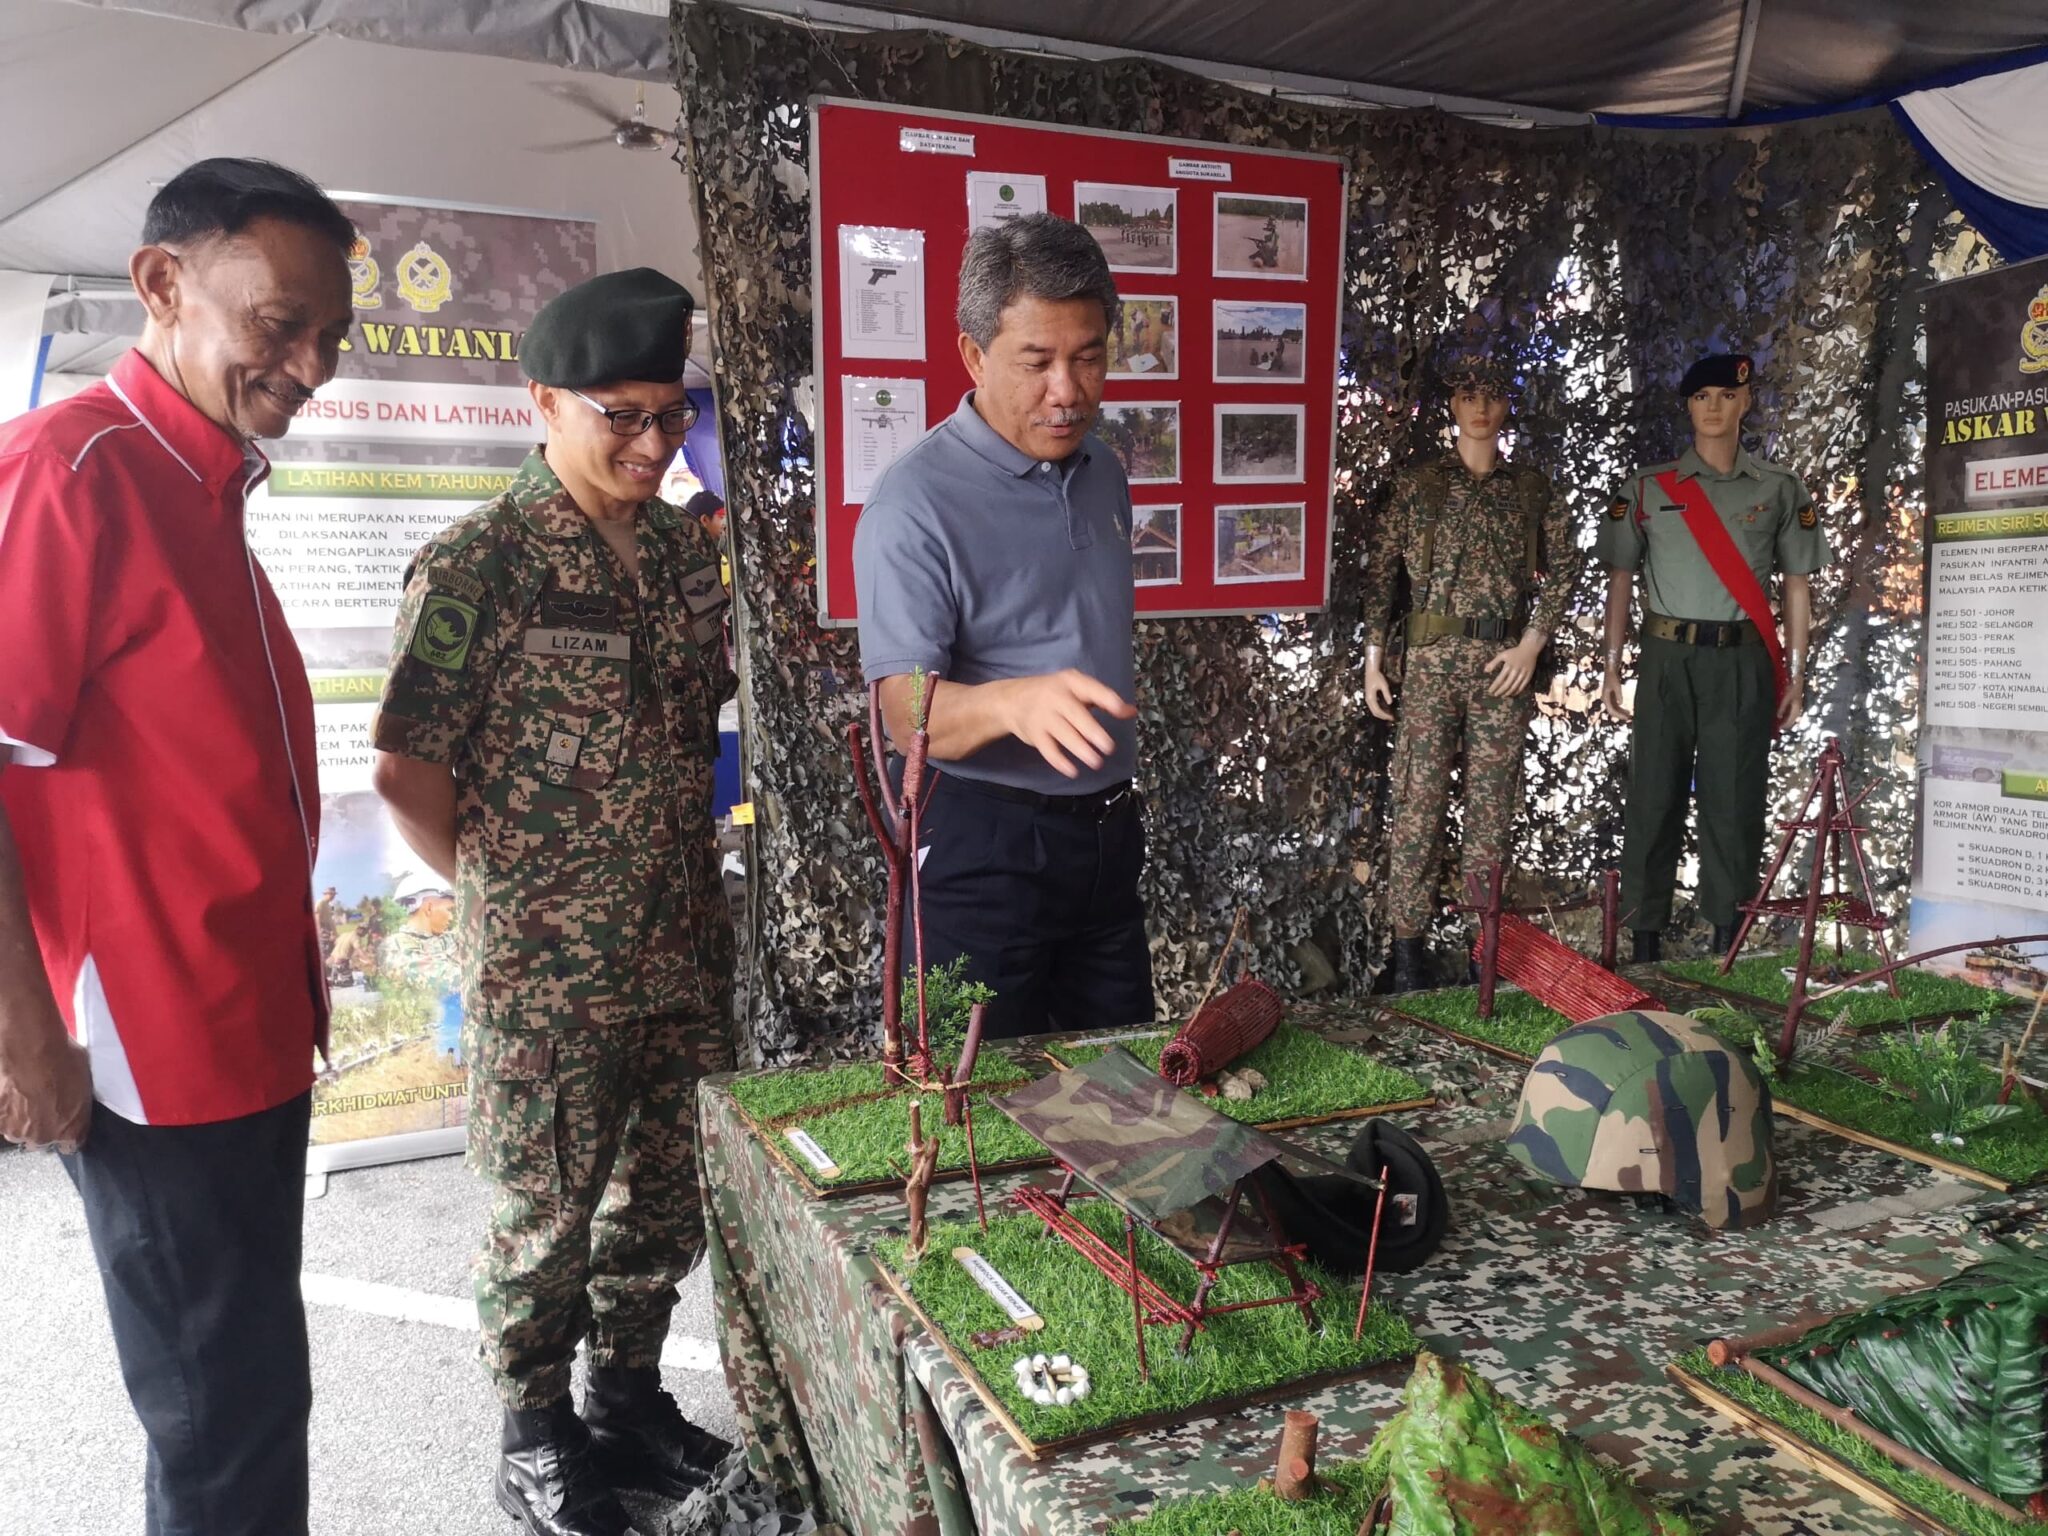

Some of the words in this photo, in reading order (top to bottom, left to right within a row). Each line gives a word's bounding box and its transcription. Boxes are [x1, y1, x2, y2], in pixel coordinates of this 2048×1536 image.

[361, 323, 523, 361] WATANI
[1945, 387, 2048, 418] PASUKAN-PASU
[377, 402, 427, 422] DAN
[434, 404, 532, 426] LATIHAN
[1940, 409, 2036, 445] ASKAR
[287, 470, 375, 487] LATIHAN
[381, 473, 422, 489] KEM
[1975, 465, 2048, 492] ELEME
[247, 512, 291, 521] TIHAN
[295, 513, 314, 521] INI
[318, 513, 404, 524] MERUPAKAN
[1938, 518, 1997, 534] REJIMEN
[2000, 516, 2030, 530] SIRI
[279, 530, 388, 540] DILAKSANAKAN
[252, 547, 292, 556] NGAN
[306, 547, 417, 557] MENGAPLIKASIK
[1940, 547, 1978, 557] ELEMEN
[1980, 547, 1995, 555] INI
[1940, 560, 1986, 569] PASUKAN
[1991, 558, 2037, 567] INFANTRI
[289, 564, 351, 575] PERANG,
[1939, 574, 1966, 582] ENAM
[1969, 573, 2003, 581] BELAS
[337, 582, 403, 591] REJIMENT
[1939, 586, 1985, 595] MALAYSIA
[1988, 585, 2017, 594] PADA
[334, 598, 402, 608] BERTERUS
[1942, 609, 1958, 617] REJ
[1959, 608, 1976, 617] 501
[1983, 608, 2015, 617] JOHOR
[1942, 621, 1958, 629] REJ
[1959, 620, 1978, 629] 502
[1983, 621, 2034, 629] SELANGOR
[1941, 633, 1957, 641] REJ
[1959, 633, 1977, 641] 503
[1983, 633, 2015, 641] PERAK
[551, 635, 608, 653] LIZAM
[1941, 646, 1957, 654] REJ
[1959, 646, 1977, 654] 504
[1984, 646, 2016, 655] PERLIS
[1959, 659, 1978, 667] 505
[1983, 659, 2022, 667] PAHANG
[1958, 670, 1977, 679] 506
[1983, 672, 2031, 680] KELANTAN
[1958, 682, 1976, 691] 507
[1982, 684, 2007, 692] KOTA
[2008, 685, 2048, 693] KINABAL
[1982, 692, 2014, 700] SABAH
[1940, 700, 1956, 708] REJ
[1958, 700, 1976, 709] 508
[1982, 702, 2016, 711] NEGERI
[2017, 704, 2048, 712] SEMBIL
[318, 756, 369, 767] ATIHAN
[1933, 800, 1952, 809] KOR
[1955, 802, 1990, 812] ARMOR
[1993, 806, 2028, 817] DIRAJA
[2031, 809, 2048, 819] TEL
[1933, 810, 1968, 820] ARMOR
[1972, 812, 1997, 823] (AW)
[2001, 816, 2028, 827] YANG
[1999, 827, 2048, 840] SKUADRO
[1968, 842, 2023, 857] SKUADRON
[1968, 855, 2022, 869] SKUADRON
[1968, 867, 2022, 882] SKUADRON
[1968, 878, 2021, 894] SKUADRON
[312, 1089, 417, 1117] RKHIDMAT
[421, 1082, 468, 1101] UNTU
